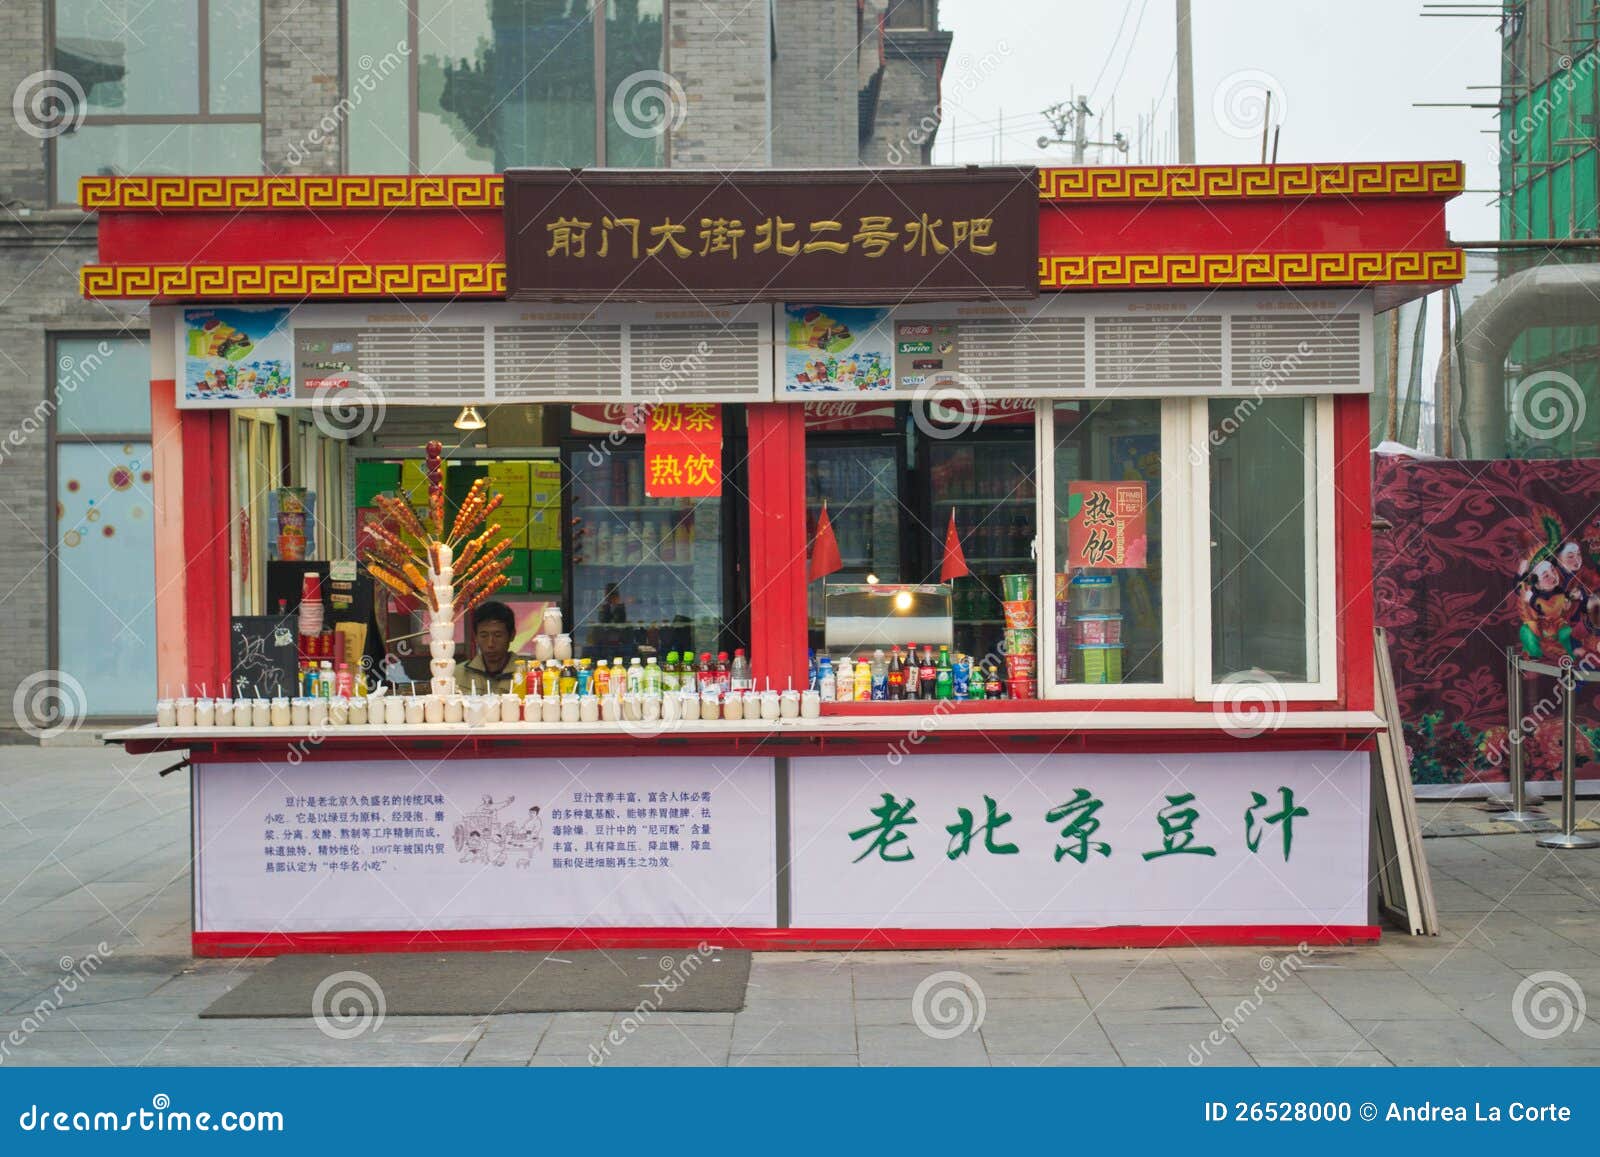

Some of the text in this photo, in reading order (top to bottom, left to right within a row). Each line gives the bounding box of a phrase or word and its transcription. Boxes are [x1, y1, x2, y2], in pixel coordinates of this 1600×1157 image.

[546, 212, 998, 260] 前门大街北二号水吧
[900, 343, 931, 353] Sprite
[651, 402, 716, 432] 奶茶
[651, 453, 716, 486] 热饮
[1081, 490, 1116, 566] 热饮
[285, 794, 445, 808] 豆汁是老北京久负盛名的传统风味
[848, 786, 1309, 864] 老北京豆汁
